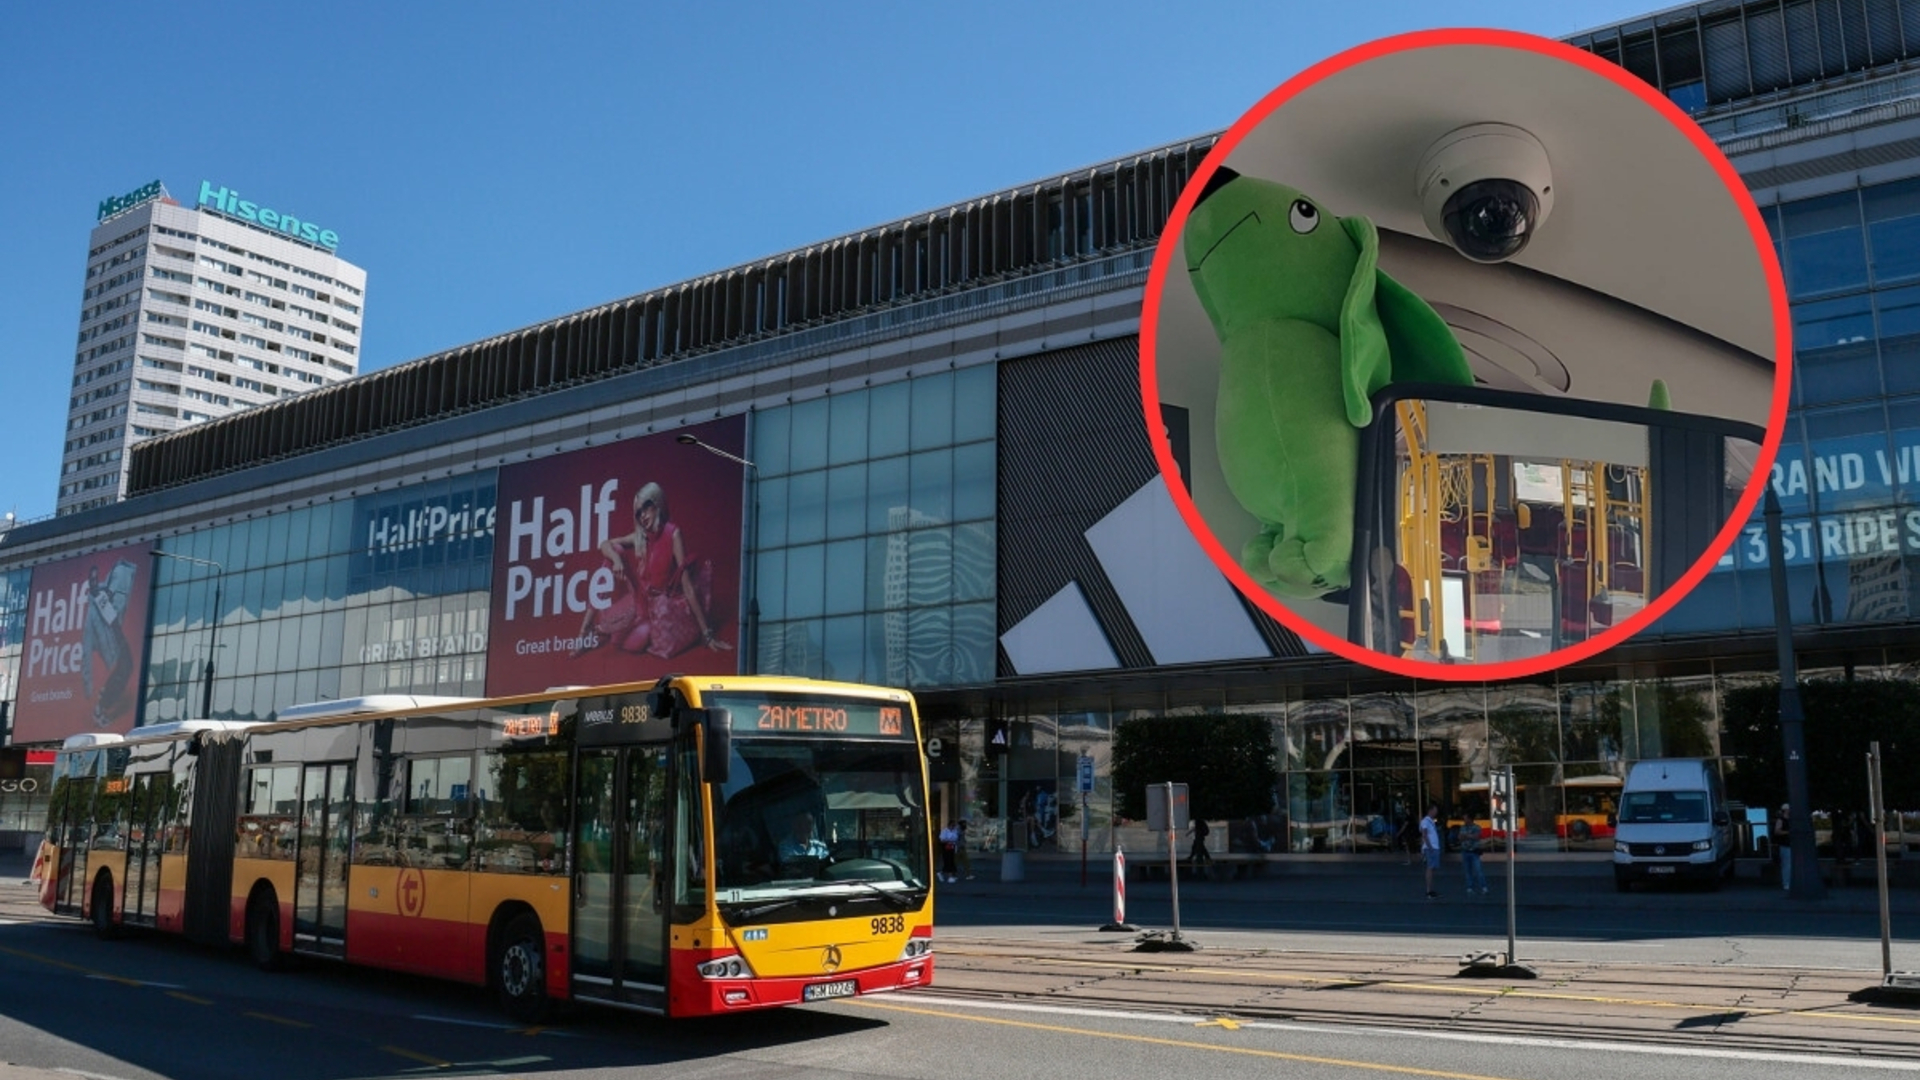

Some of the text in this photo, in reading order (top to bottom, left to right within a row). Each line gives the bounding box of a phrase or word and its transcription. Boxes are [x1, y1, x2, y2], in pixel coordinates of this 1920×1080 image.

[98, 179, 161, 220] Hisense
[198, 180, 339, 249] Hisense
[1769, 453, 1865, 499] RAND
[367, 503, 498, 557] HalfPrice
[508, 478, 619, 563] Half
[32, 580, 90, 637] Half
[505, 562, 615, 621] Price
[27, 637, 83, 678] Price
[417, 632, 488, 657] BRAND
[516, 632, 599, 655] Great brands
[621, 706, 647, 723] 9838
[871, 916, 904, 934] 9838
